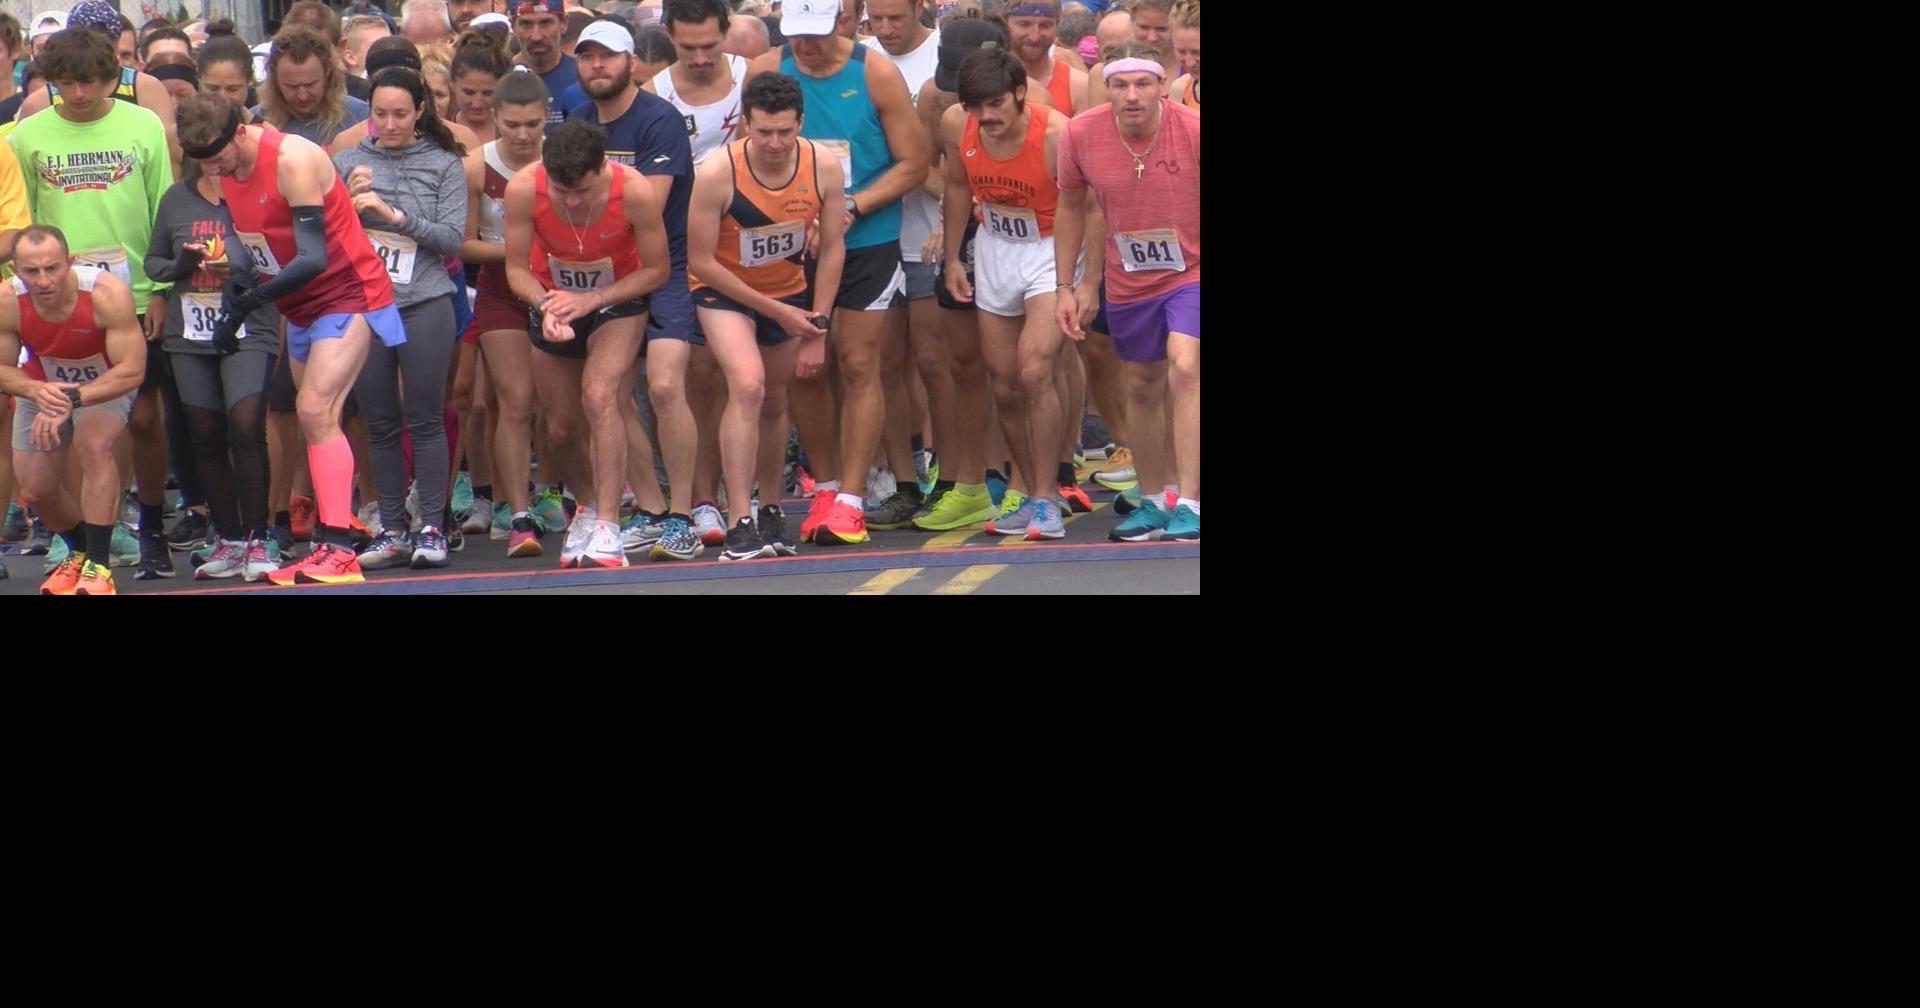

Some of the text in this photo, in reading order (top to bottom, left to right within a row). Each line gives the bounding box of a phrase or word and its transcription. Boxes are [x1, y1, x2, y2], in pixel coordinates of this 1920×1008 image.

[67, 150, 123, 167] HERRMANN
[58, 172, 113, 187] INVITATIONAL
[997, 176, 1036, 197] RUNNERS
[990, 211, 1028, 238] 540
[752, 232, 794, 259] 563
[1130, 240, 1174, 263] 641
[559, 269, 602, 289] 507
[56, 366, 99, 382] 426
